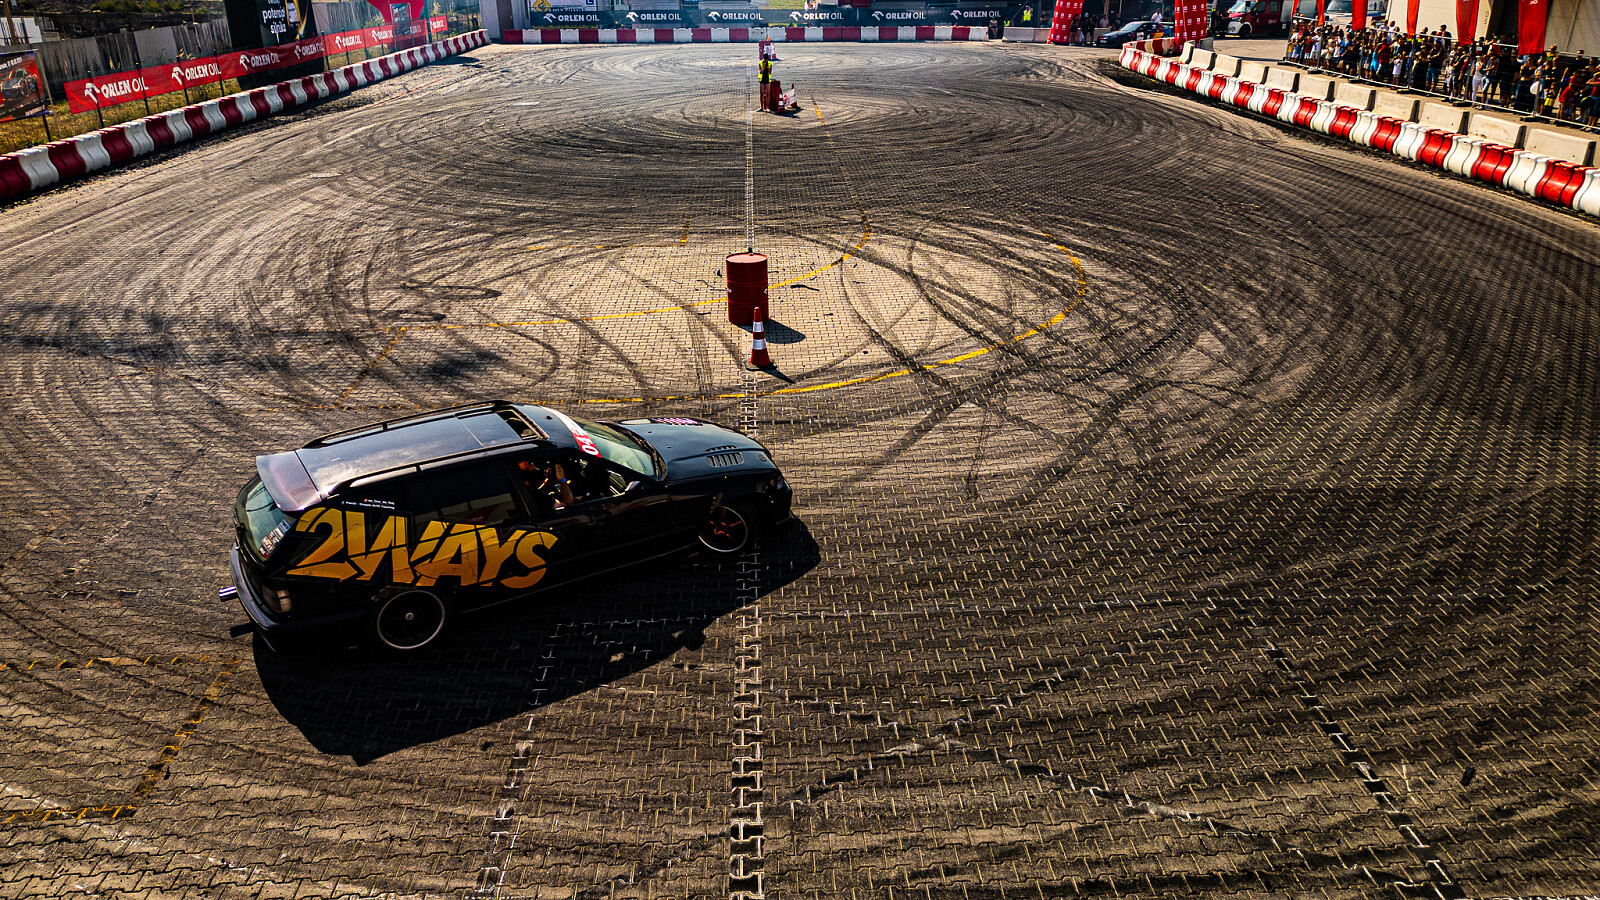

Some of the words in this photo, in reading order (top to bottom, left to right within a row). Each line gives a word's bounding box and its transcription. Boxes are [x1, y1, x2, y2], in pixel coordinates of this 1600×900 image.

[558, 14, 585, 22] ORLEN
[586, 14, 600, 22] OIL
[640, 13, 667, 21] ORLEN
[668, 13, 682, 21] OIL
[722, 12, 749, 20] ORLEN
[750, 12, 763, 20] OIL
[803, 12, 830, 20] ORLEN
[831, 12, 844, 20] OIL
[886, 12, 912, 20] ORLEN
[913, 12, 926, 20] OIL
[963, 10, 988, 18] ORLEN
[989, 10, 1002, 18] OIL
[301, 44, 317, 56] ORLEN
[251, 54, 271, 67] ORLEN
[270, 52, 281, 63] OIL
[184, 65, 209, 81] ORLEN
[208, 63, 222, 76] OIL
[101, 81, 131, 98] ORLEN
[132, 77, 149, 92] OIL
[286, 507, 559, 589] 2WAYS
